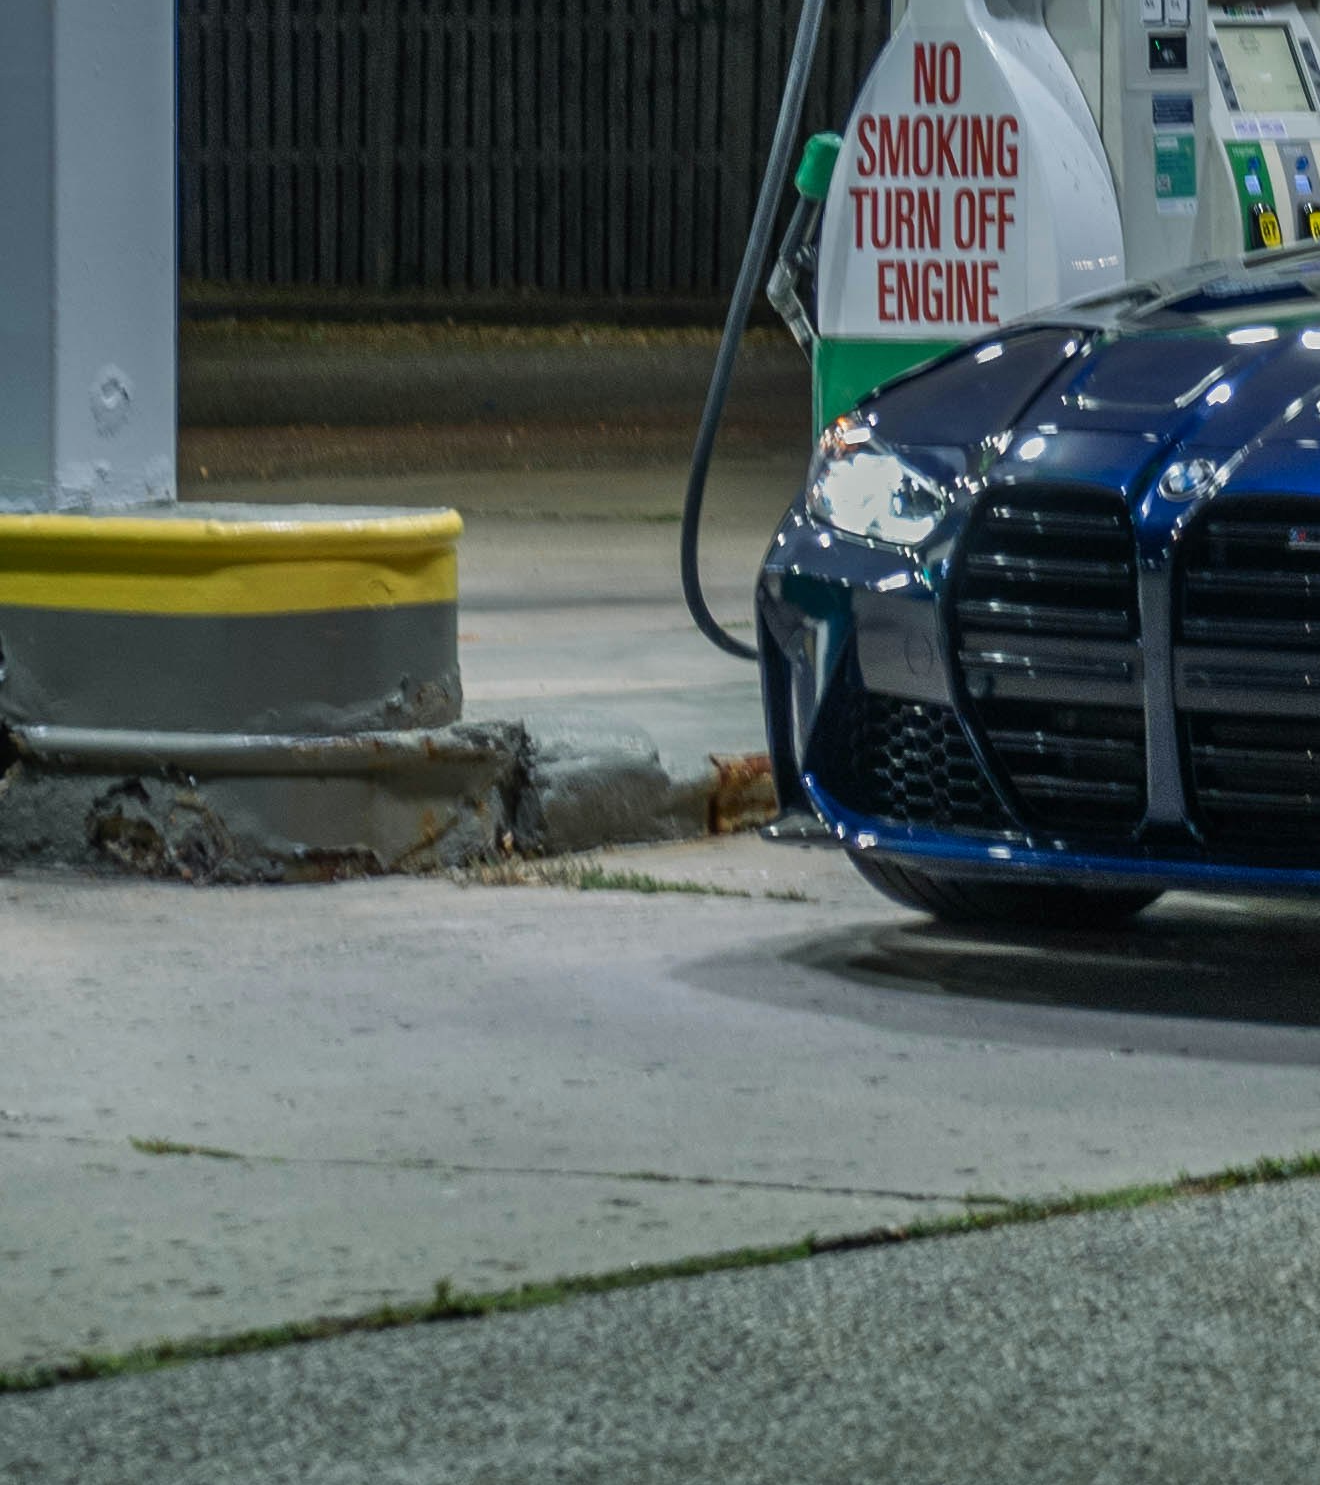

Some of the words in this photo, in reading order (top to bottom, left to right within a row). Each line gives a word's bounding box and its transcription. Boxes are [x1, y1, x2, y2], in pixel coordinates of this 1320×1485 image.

[914, 42, 962, 105] NO
[857, 114, 1018, 178] SMOKING
[849, 187, 941, 250] TURN
[954, 187, 1016, 252] OFF
[877, 260, 1000, 324] ENGINE
